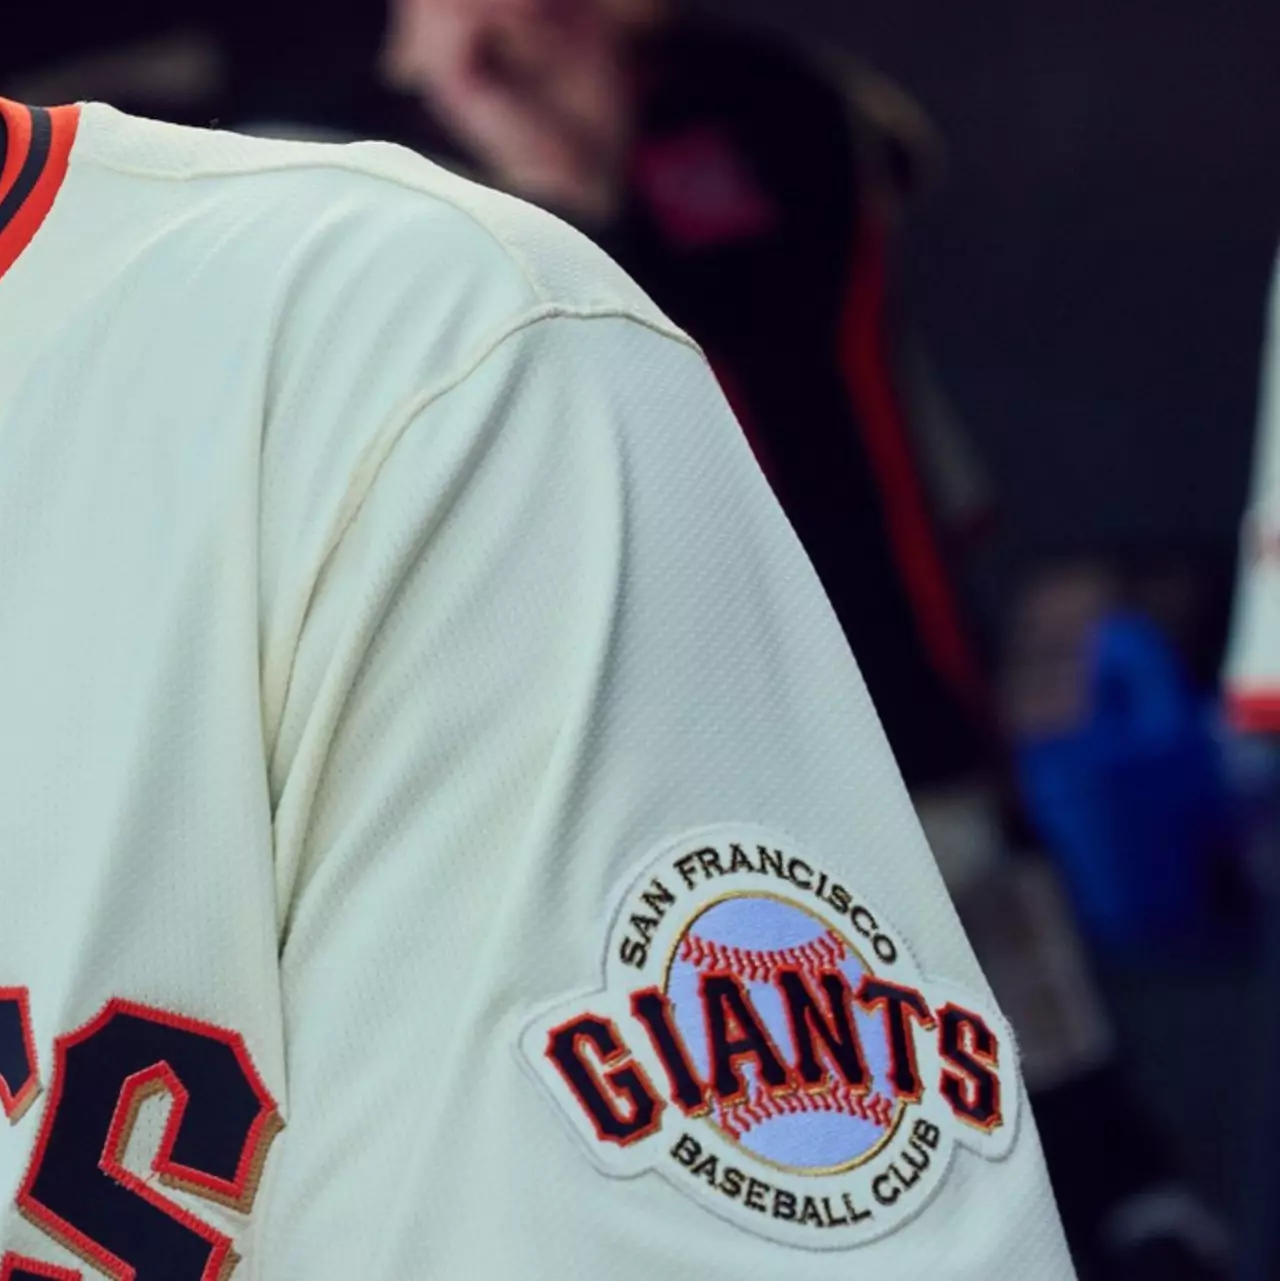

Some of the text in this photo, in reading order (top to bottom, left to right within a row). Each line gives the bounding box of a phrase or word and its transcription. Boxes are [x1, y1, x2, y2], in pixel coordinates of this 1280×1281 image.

[619, 842, 898, 970] SAN FRANCISCO
[544, 961, 1004, 1149] GIANTS
[668, 1118, 942, 1228] BASEBALL CLUB
